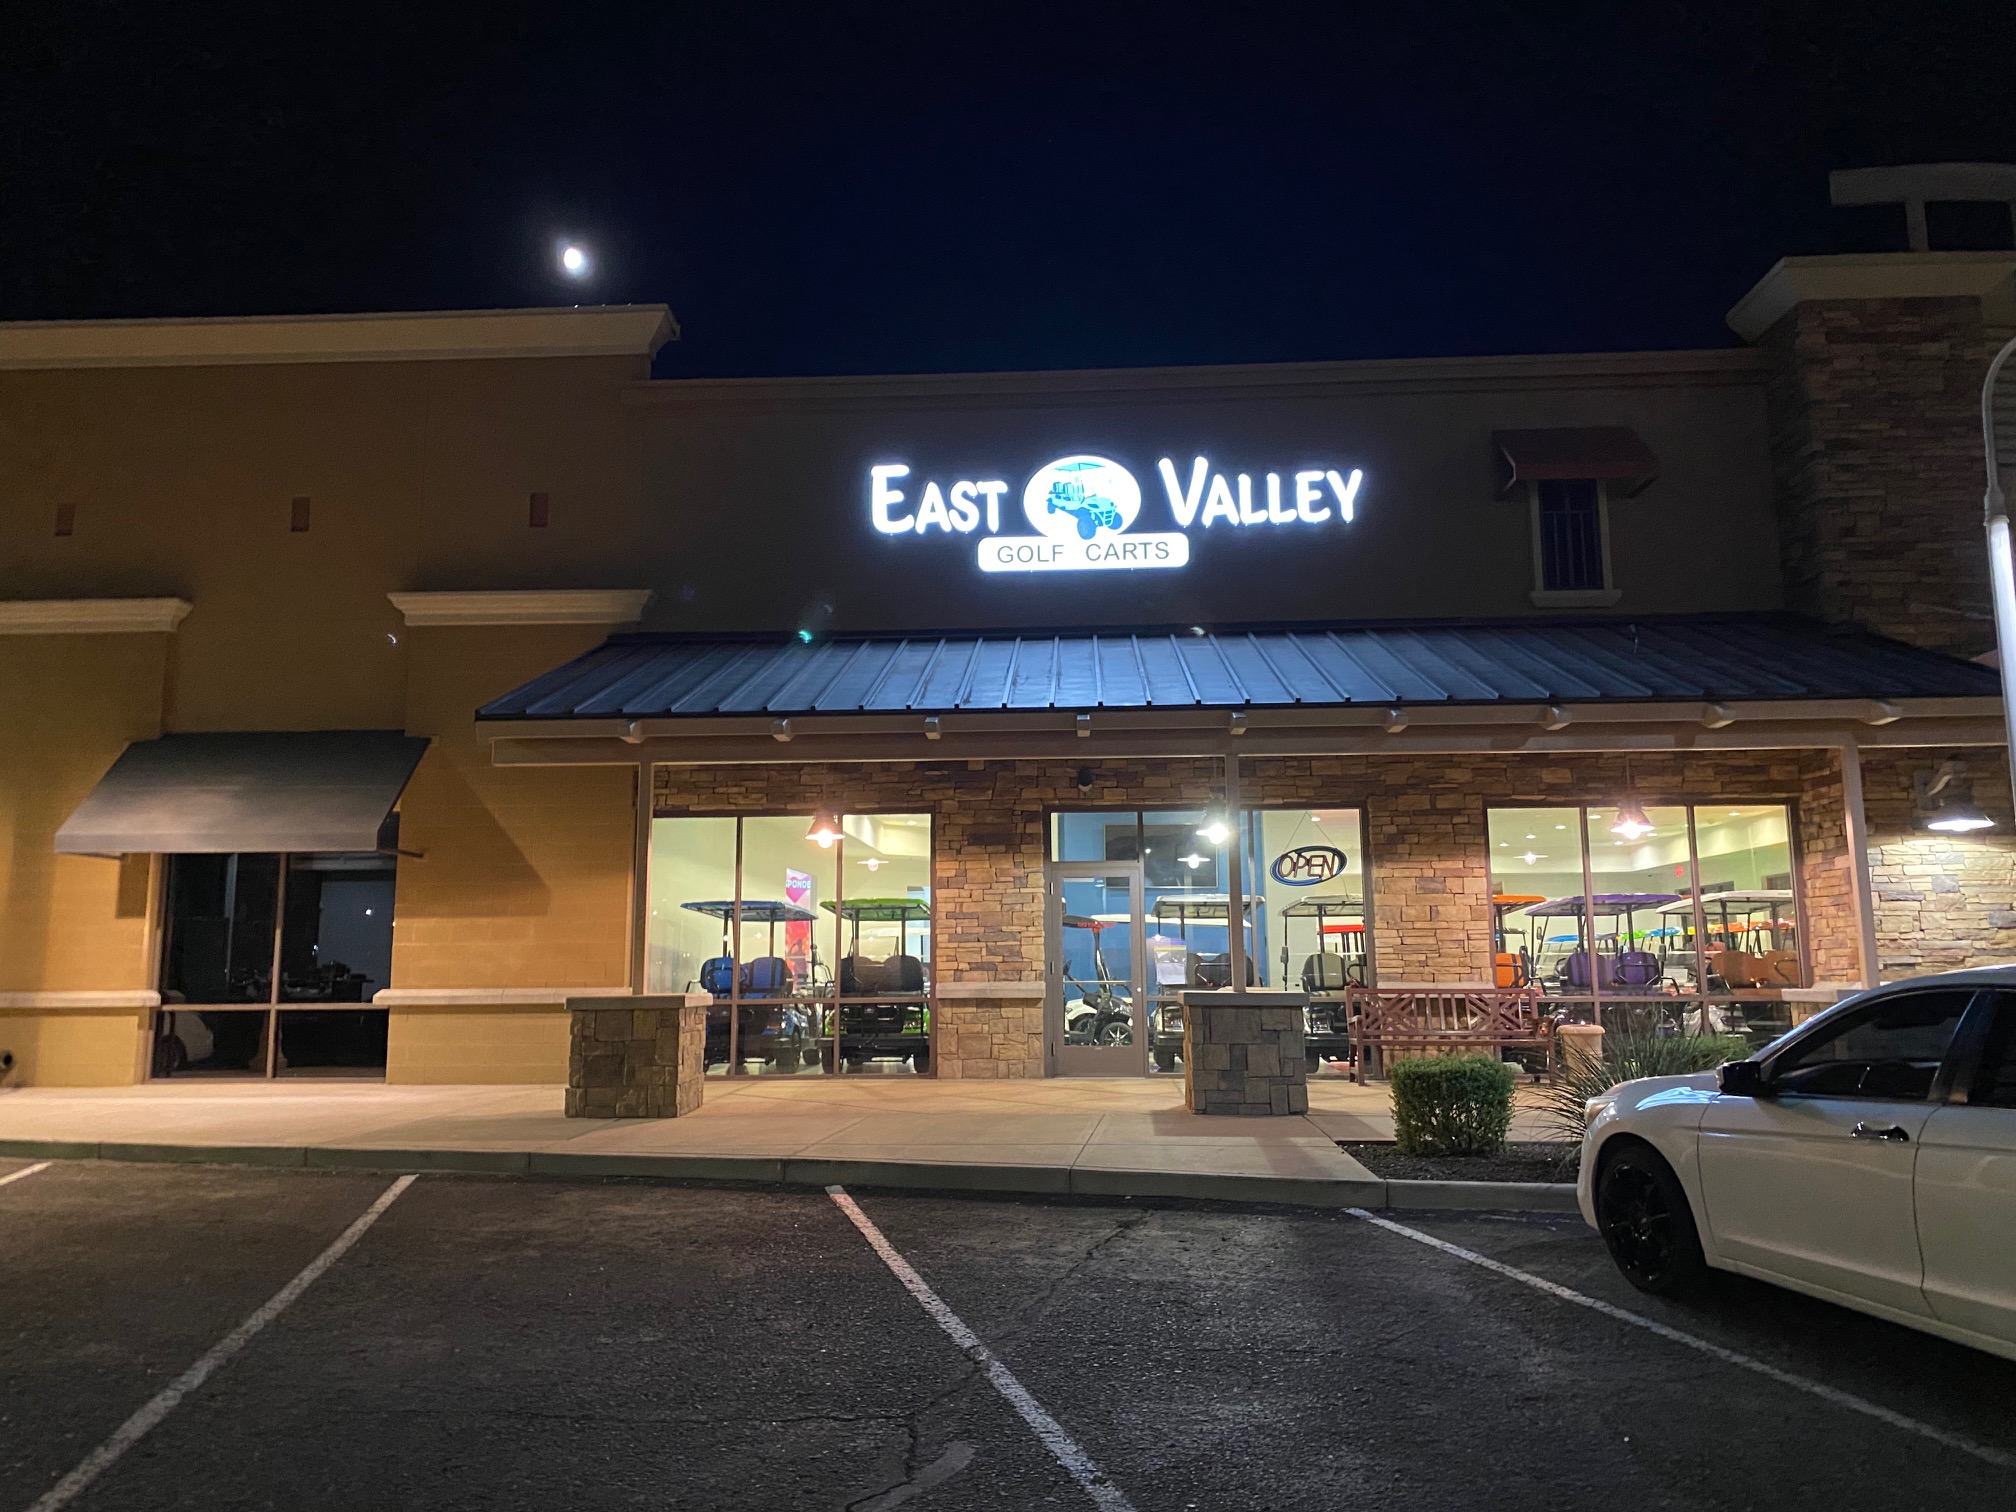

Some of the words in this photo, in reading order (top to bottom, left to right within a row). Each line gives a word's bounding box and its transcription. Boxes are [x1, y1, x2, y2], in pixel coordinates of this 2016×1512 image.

[870, 463, 1009, 535] EAST
[1157, 456, 1363, 527] VALLEY
[997, 544, 1065, 564] GOLF
[1085, 541, 1170, 562] CARTS
[1278, 853, 1336, 878] OPEN
